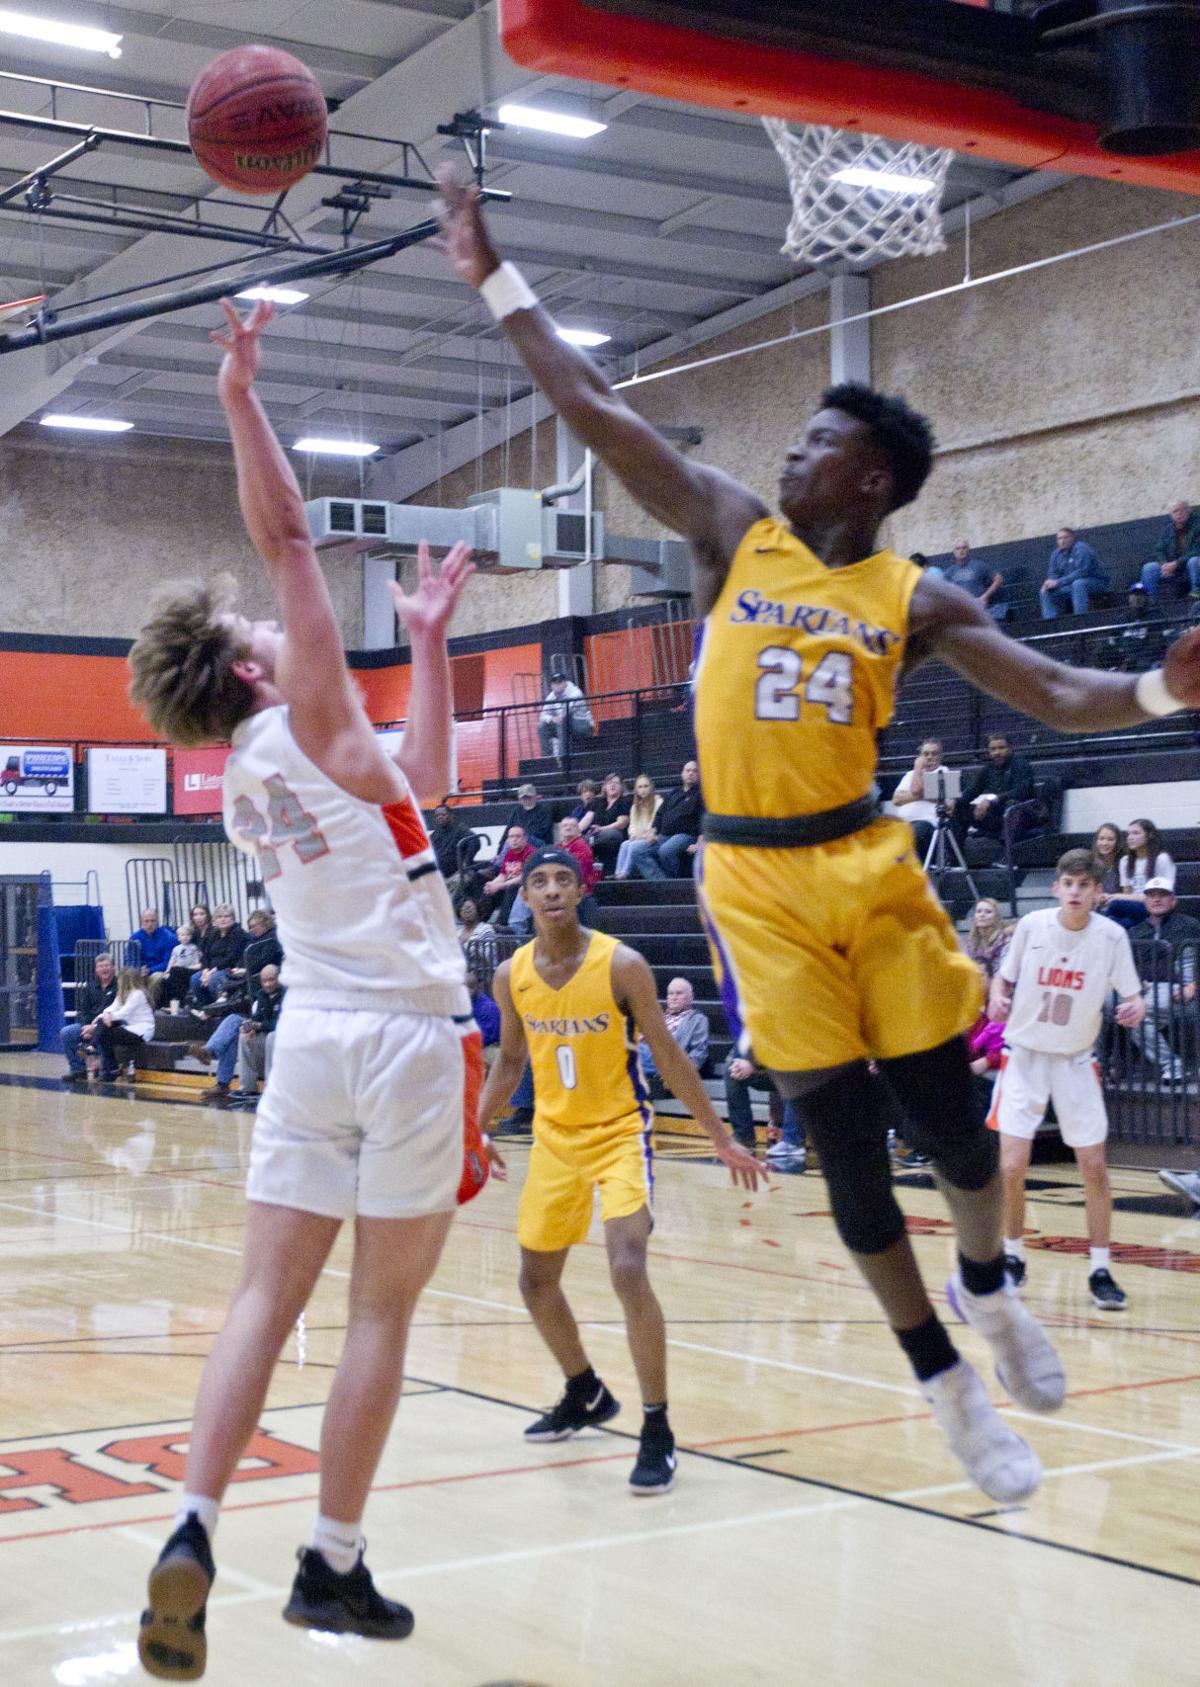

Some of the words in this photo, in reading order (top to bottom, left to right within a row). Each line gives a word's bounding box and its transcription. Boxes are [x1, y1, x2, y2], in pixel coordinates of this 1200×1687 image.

[754, 644, 853, 727] 24
[1037, 966, 1086, 991] LIONS
[1036, 991, 1074, 1026] 10
[555, 1043, 577, 1091] 0
